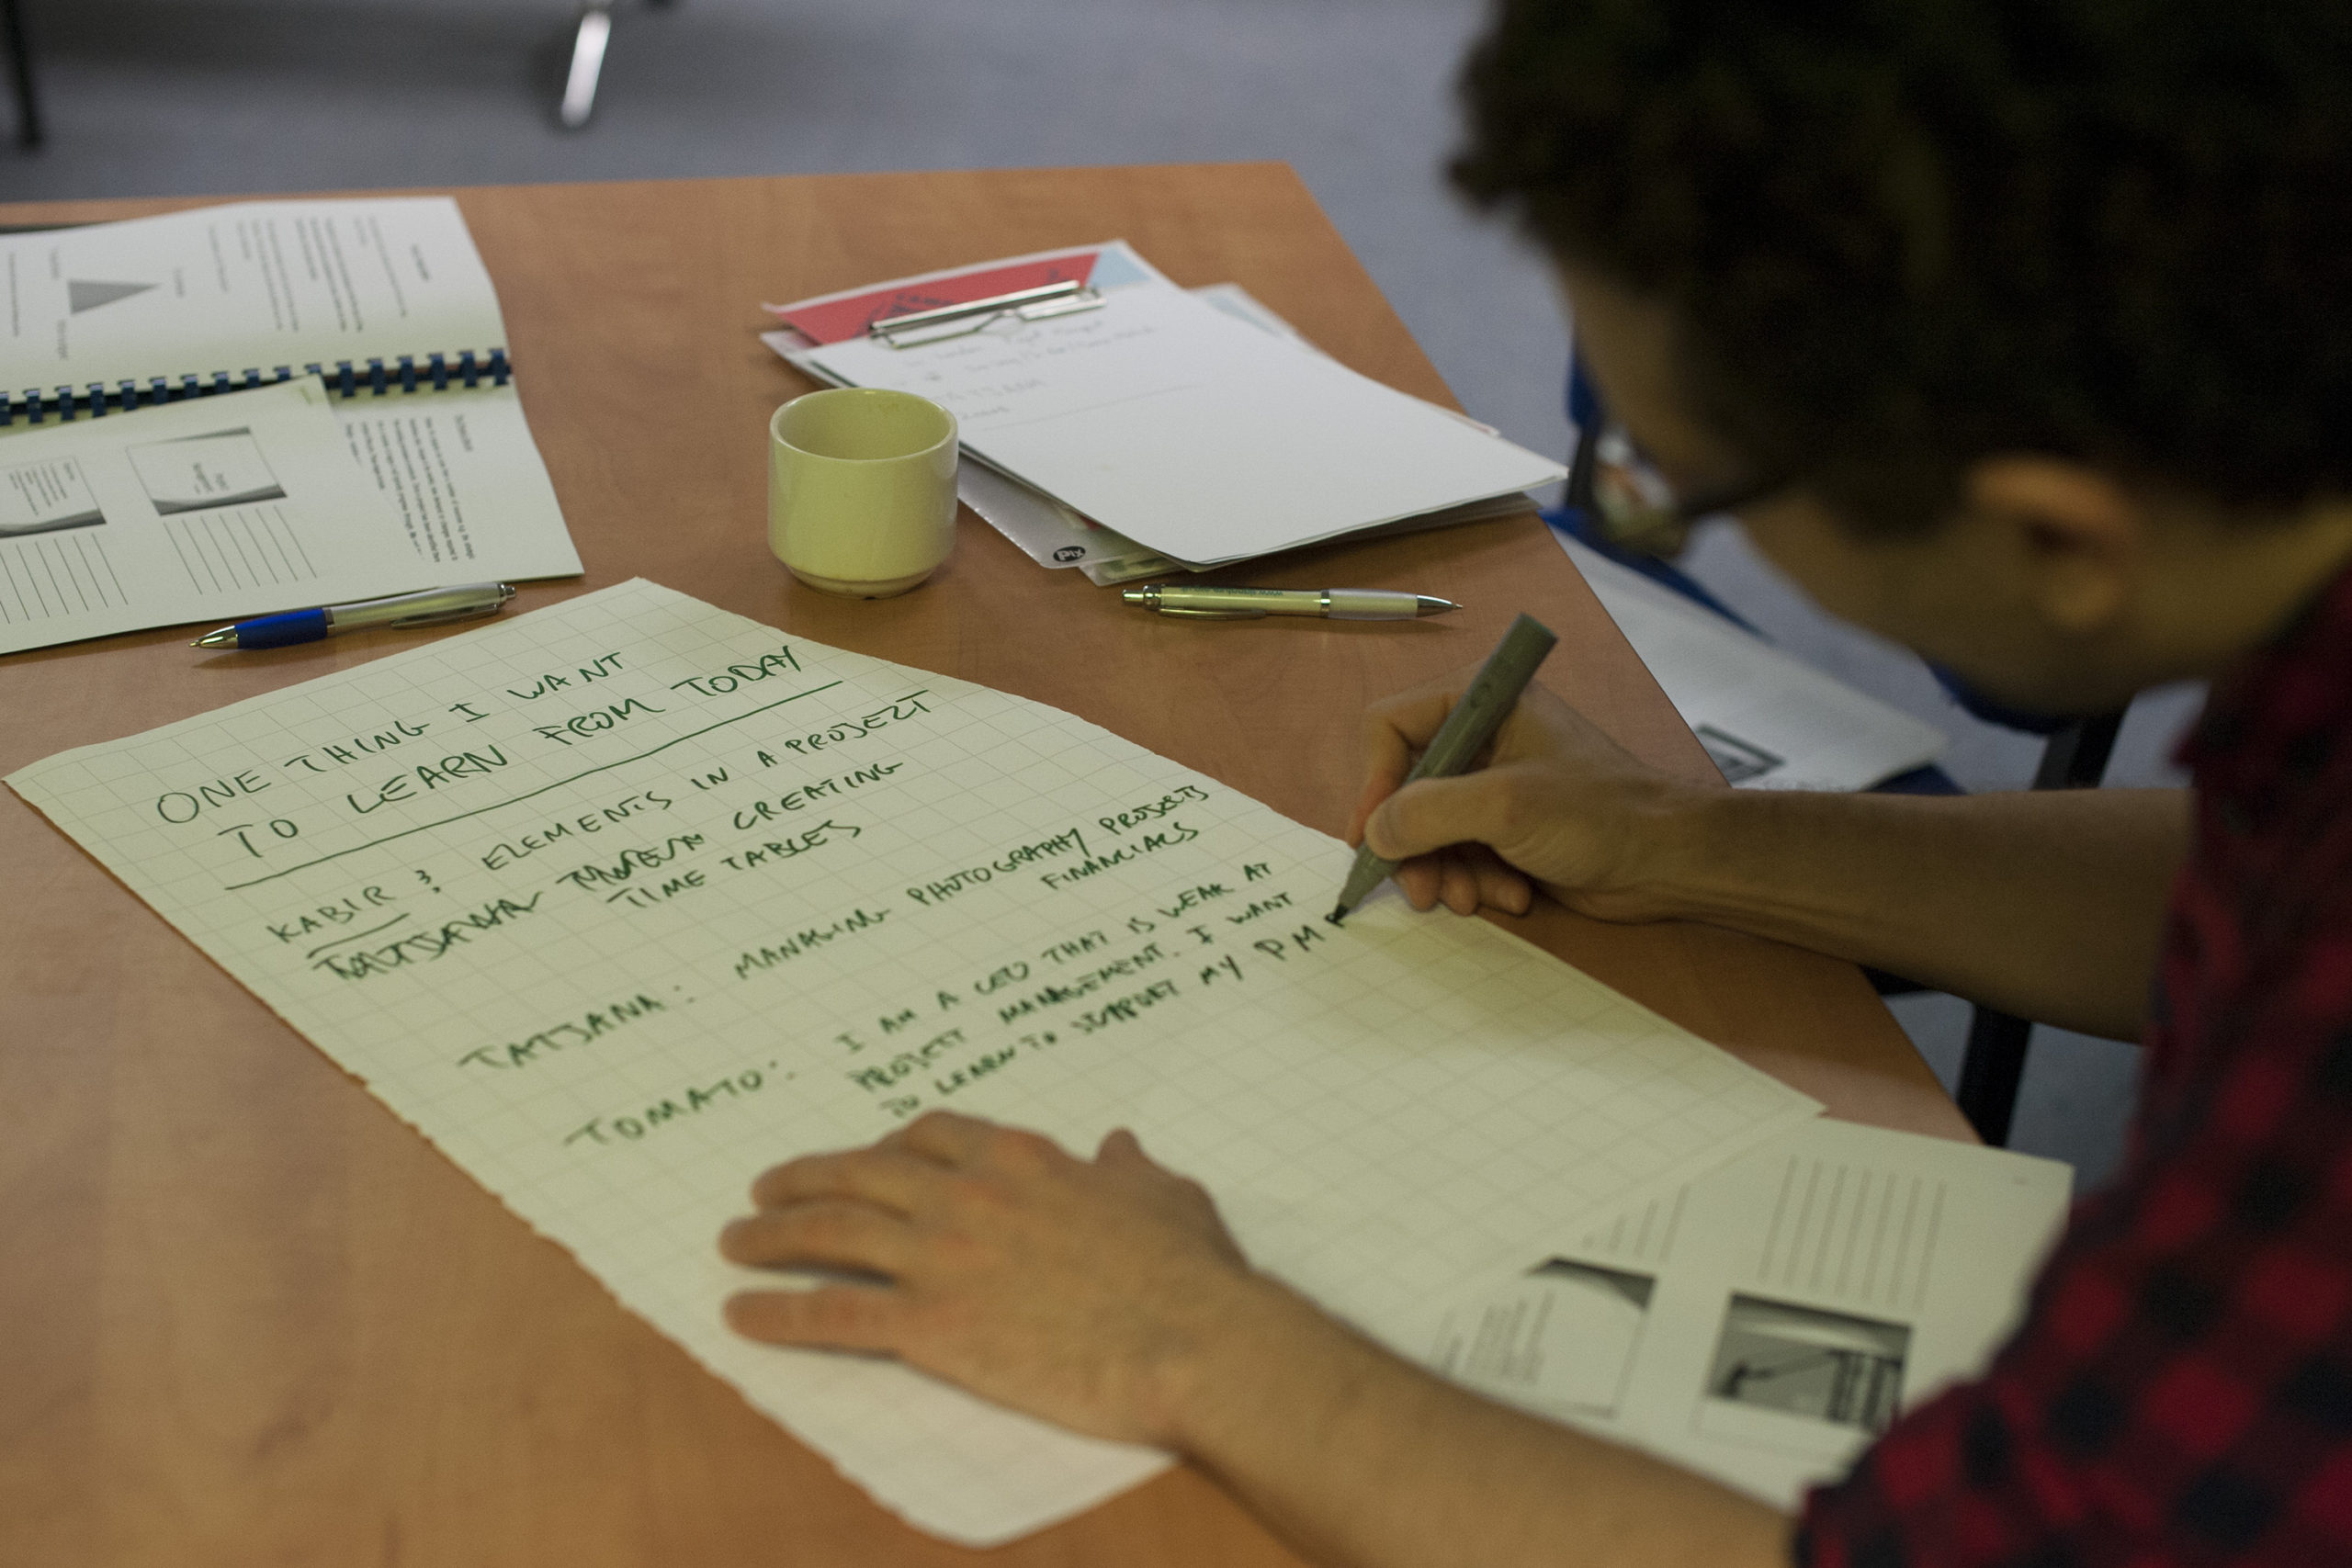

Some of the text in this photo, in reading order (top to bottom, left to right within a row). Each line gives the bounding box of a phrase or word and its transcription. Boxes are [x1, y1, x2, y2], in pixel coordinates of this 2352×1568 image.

[156, 651, 623, 824] ONE THING I WANT
[218, 645, 802, 859] TO LEARN FROM TODAY
[733, 761, 904, 831] CREATING
[481, 789, 673, 871] ELEMENTS
[690, 766, 729, 791] IN
[756, 750, 778, 768] A
[605, 869, 707, 908] TIME
[719, 818, 862, 872] TABLES
[734, 908, 892, 980] MANAGING
[905, 827, 1091, 908] PHOTOGRAPHY
[834, 1032, 865, 1055] I
[878, 1009, 917, 1034] AM
[935, 989, 960, 1011] A
[1039, 929, 1110, 964] THAT
[1125, 916, 1156, 935] IS
[1156, 882, 1236, 919] WEAK
[1243, 862, 1272, 882] AT
[1186, 924, 1214, 945] I
[1226, 891, 1295, 926] WANT
[933, 1044, 1017, 1096] LEARN
[1018, 1031, 1057, 1050] TO
[1198, 953, 1244, 987] MY
